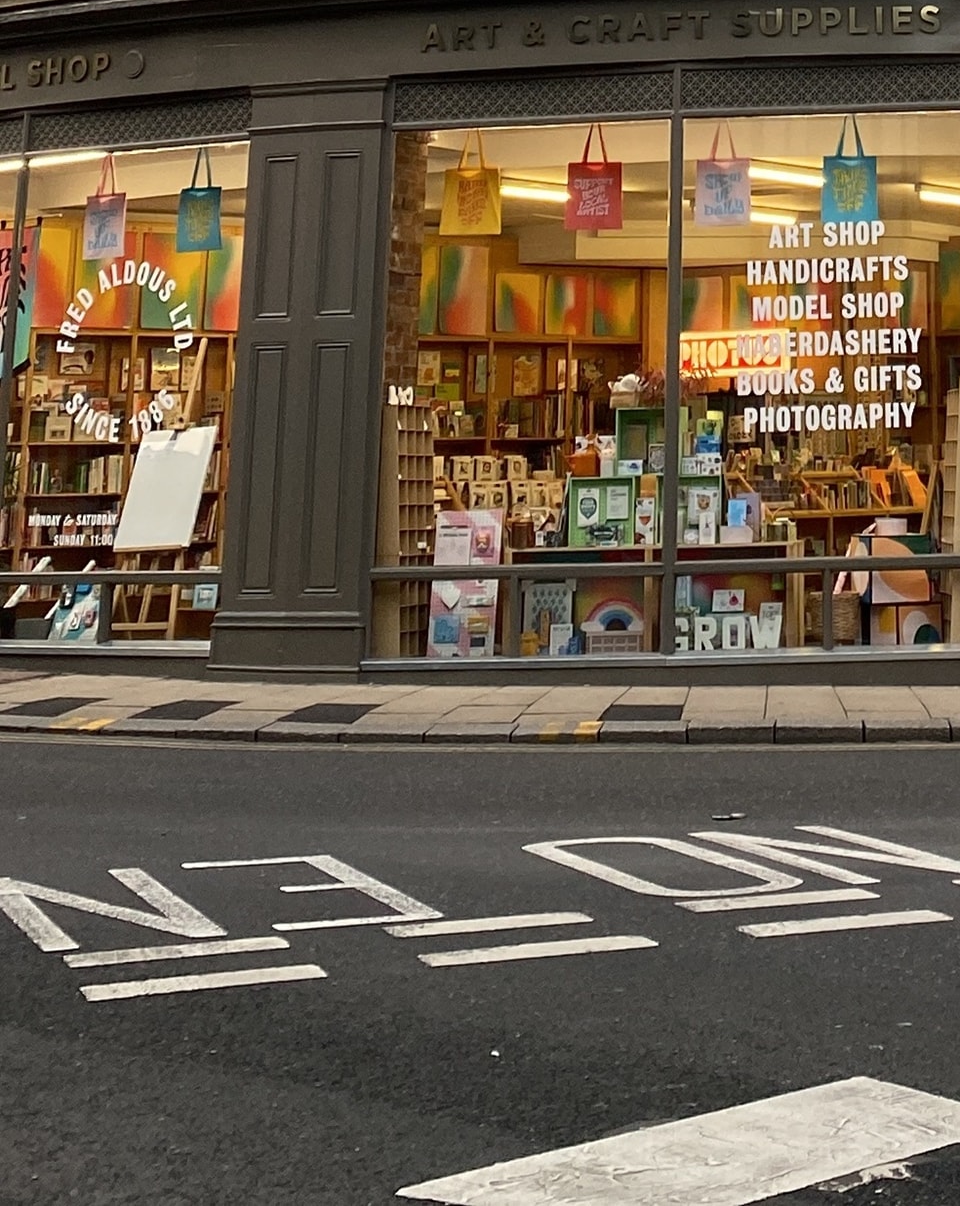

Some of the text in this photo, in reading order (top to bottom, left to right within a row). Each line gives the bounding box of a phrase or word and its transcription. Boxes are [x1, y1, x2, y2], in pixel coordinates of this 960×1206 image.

[421, 5, 943, 53] ART & CRAFT SUPPLIES
[27, 53, 111, 87] SHOP
[769, 221, 885, 249] ART SHOP
[746, 255, 909, 286] HANDICRAFTS
[56, 260, 194, 354] FRED ALDOUS LTD
[752, 292, 905, 322] MODEL SHOP
[736, 328, 922, 358] HABERDASHERY
[736, 364, 922, 396] BOOKS & GIFTS
[65, 389, 175, 443] SINCE 1886
[743, 402, 916, 433] PHOTOGRAPHY
[28, 514, 61, 527] MONDAY
[76, 513, 119, 526] SATURDAY
[53, 533, 86, 546] SUNDAY
[675, 615, 783, 651] GROW
